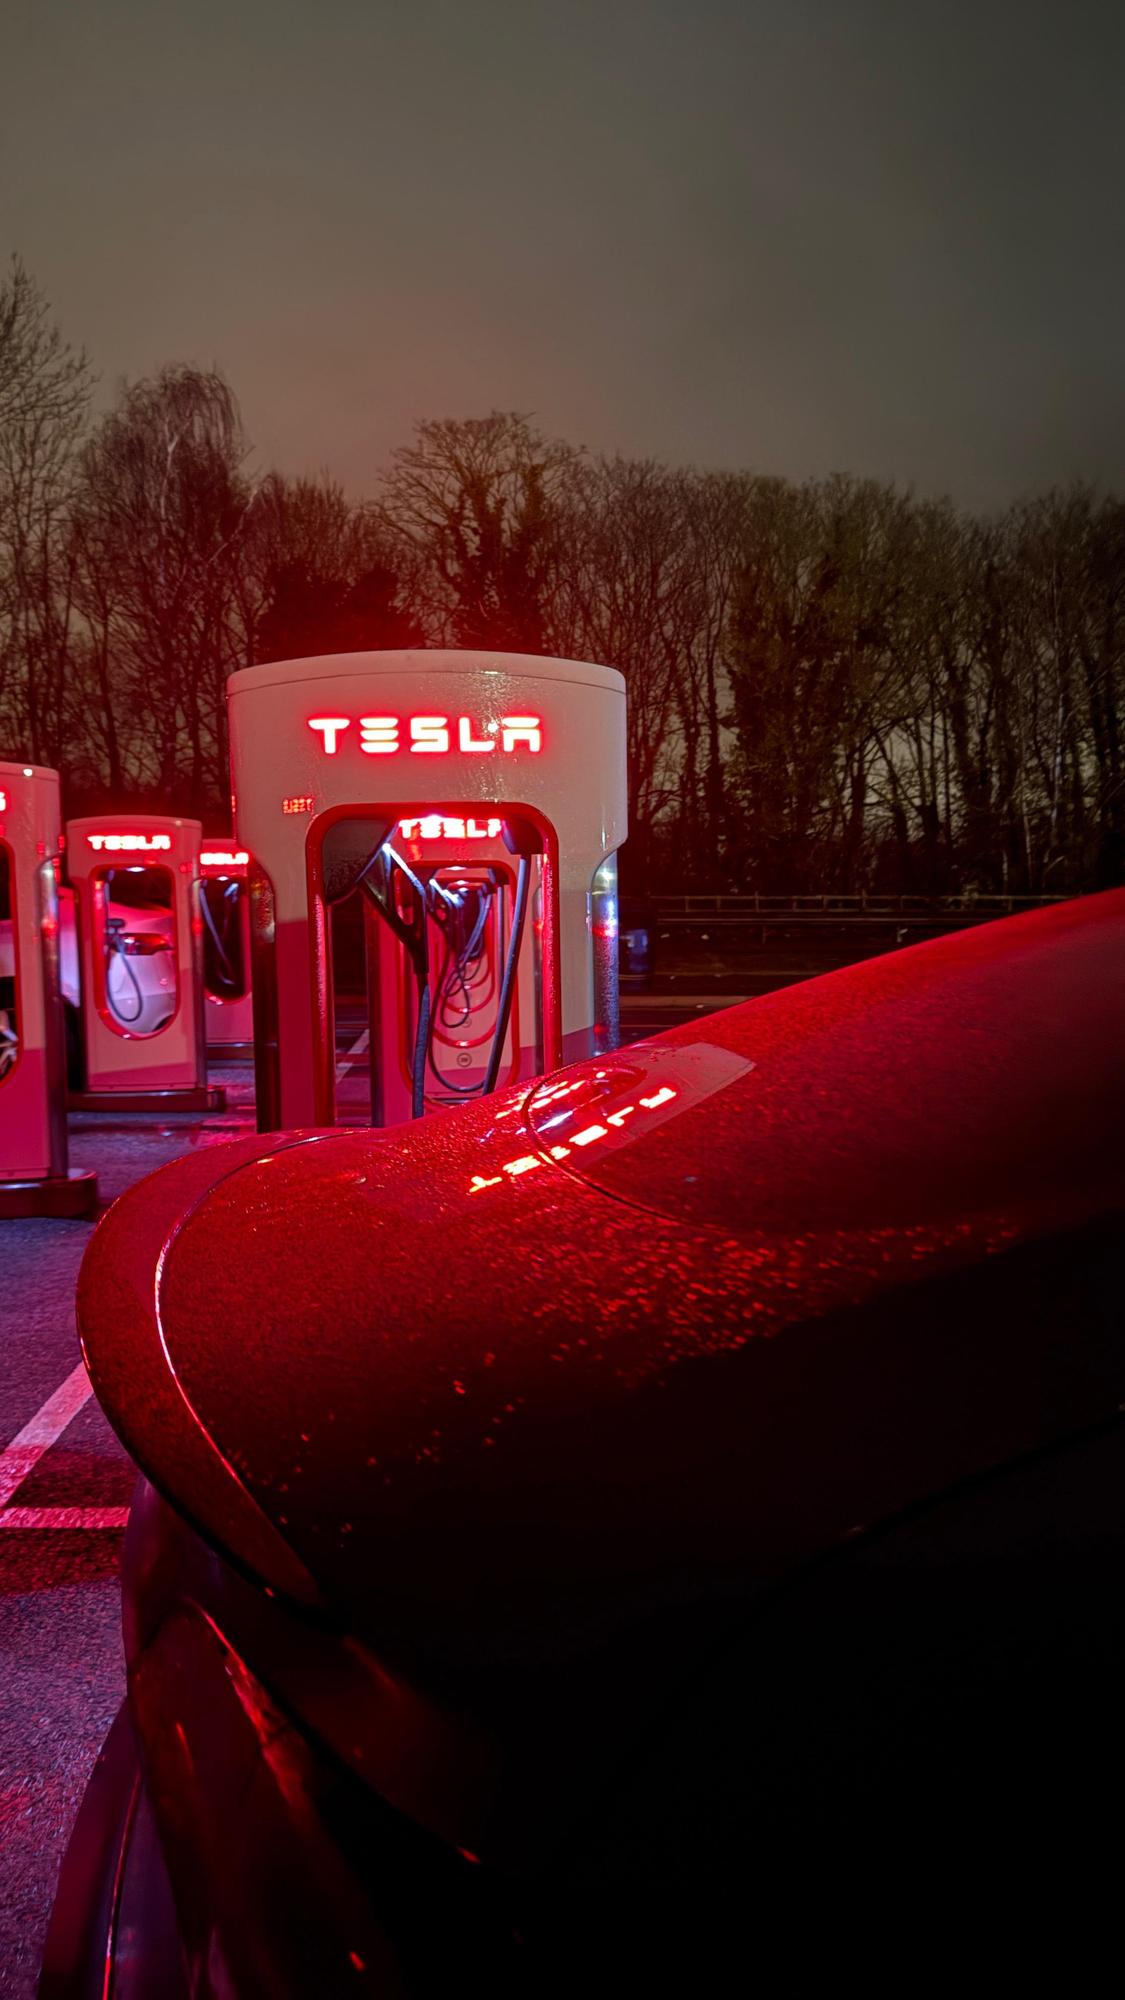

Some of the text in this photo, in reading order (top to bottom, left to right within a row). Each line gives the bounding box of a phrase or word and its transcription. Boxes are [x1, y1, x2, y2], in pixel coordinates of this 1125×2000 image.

[308, 717, 541, 753] TESLA
[88, 835, 170, 850] TESLA
[200, 852, 249, 865] ESLA
